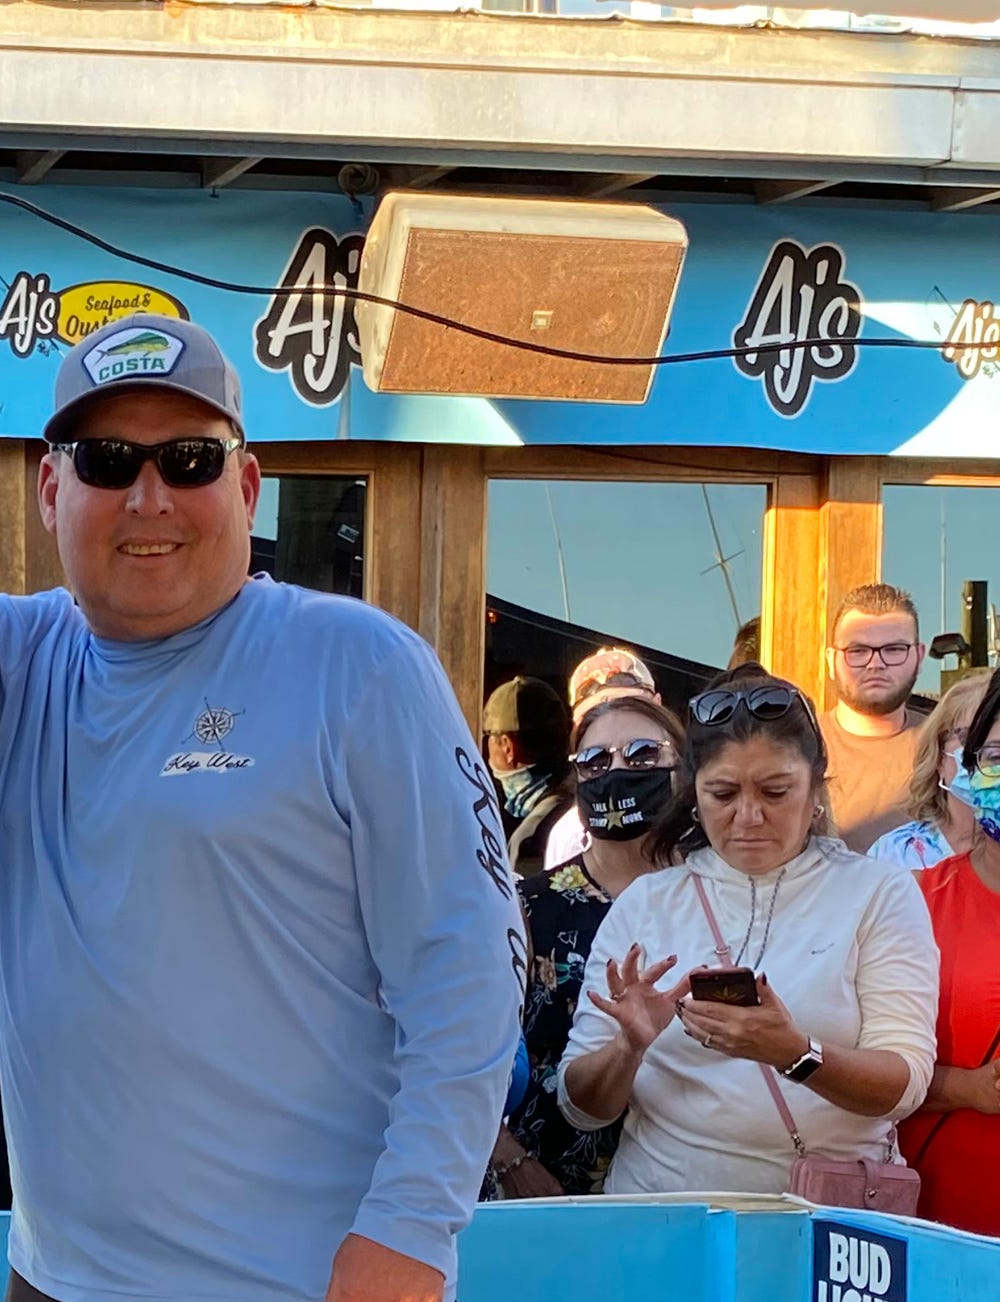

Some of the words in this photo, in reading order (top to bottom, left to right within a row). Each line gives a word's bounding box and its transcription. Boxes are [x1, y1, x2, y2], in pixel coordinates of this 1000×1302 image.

[85, 294, 140, 315] Seafood
[141, 293, 151, 307] &
[99, 357, 166, 381] COSTA
[163, 753, 201, 772] Key
[205, 752, 253, 769] West
[617, 796, 636, 810] LESS
[828, 1231, 892, 1295] BUD
